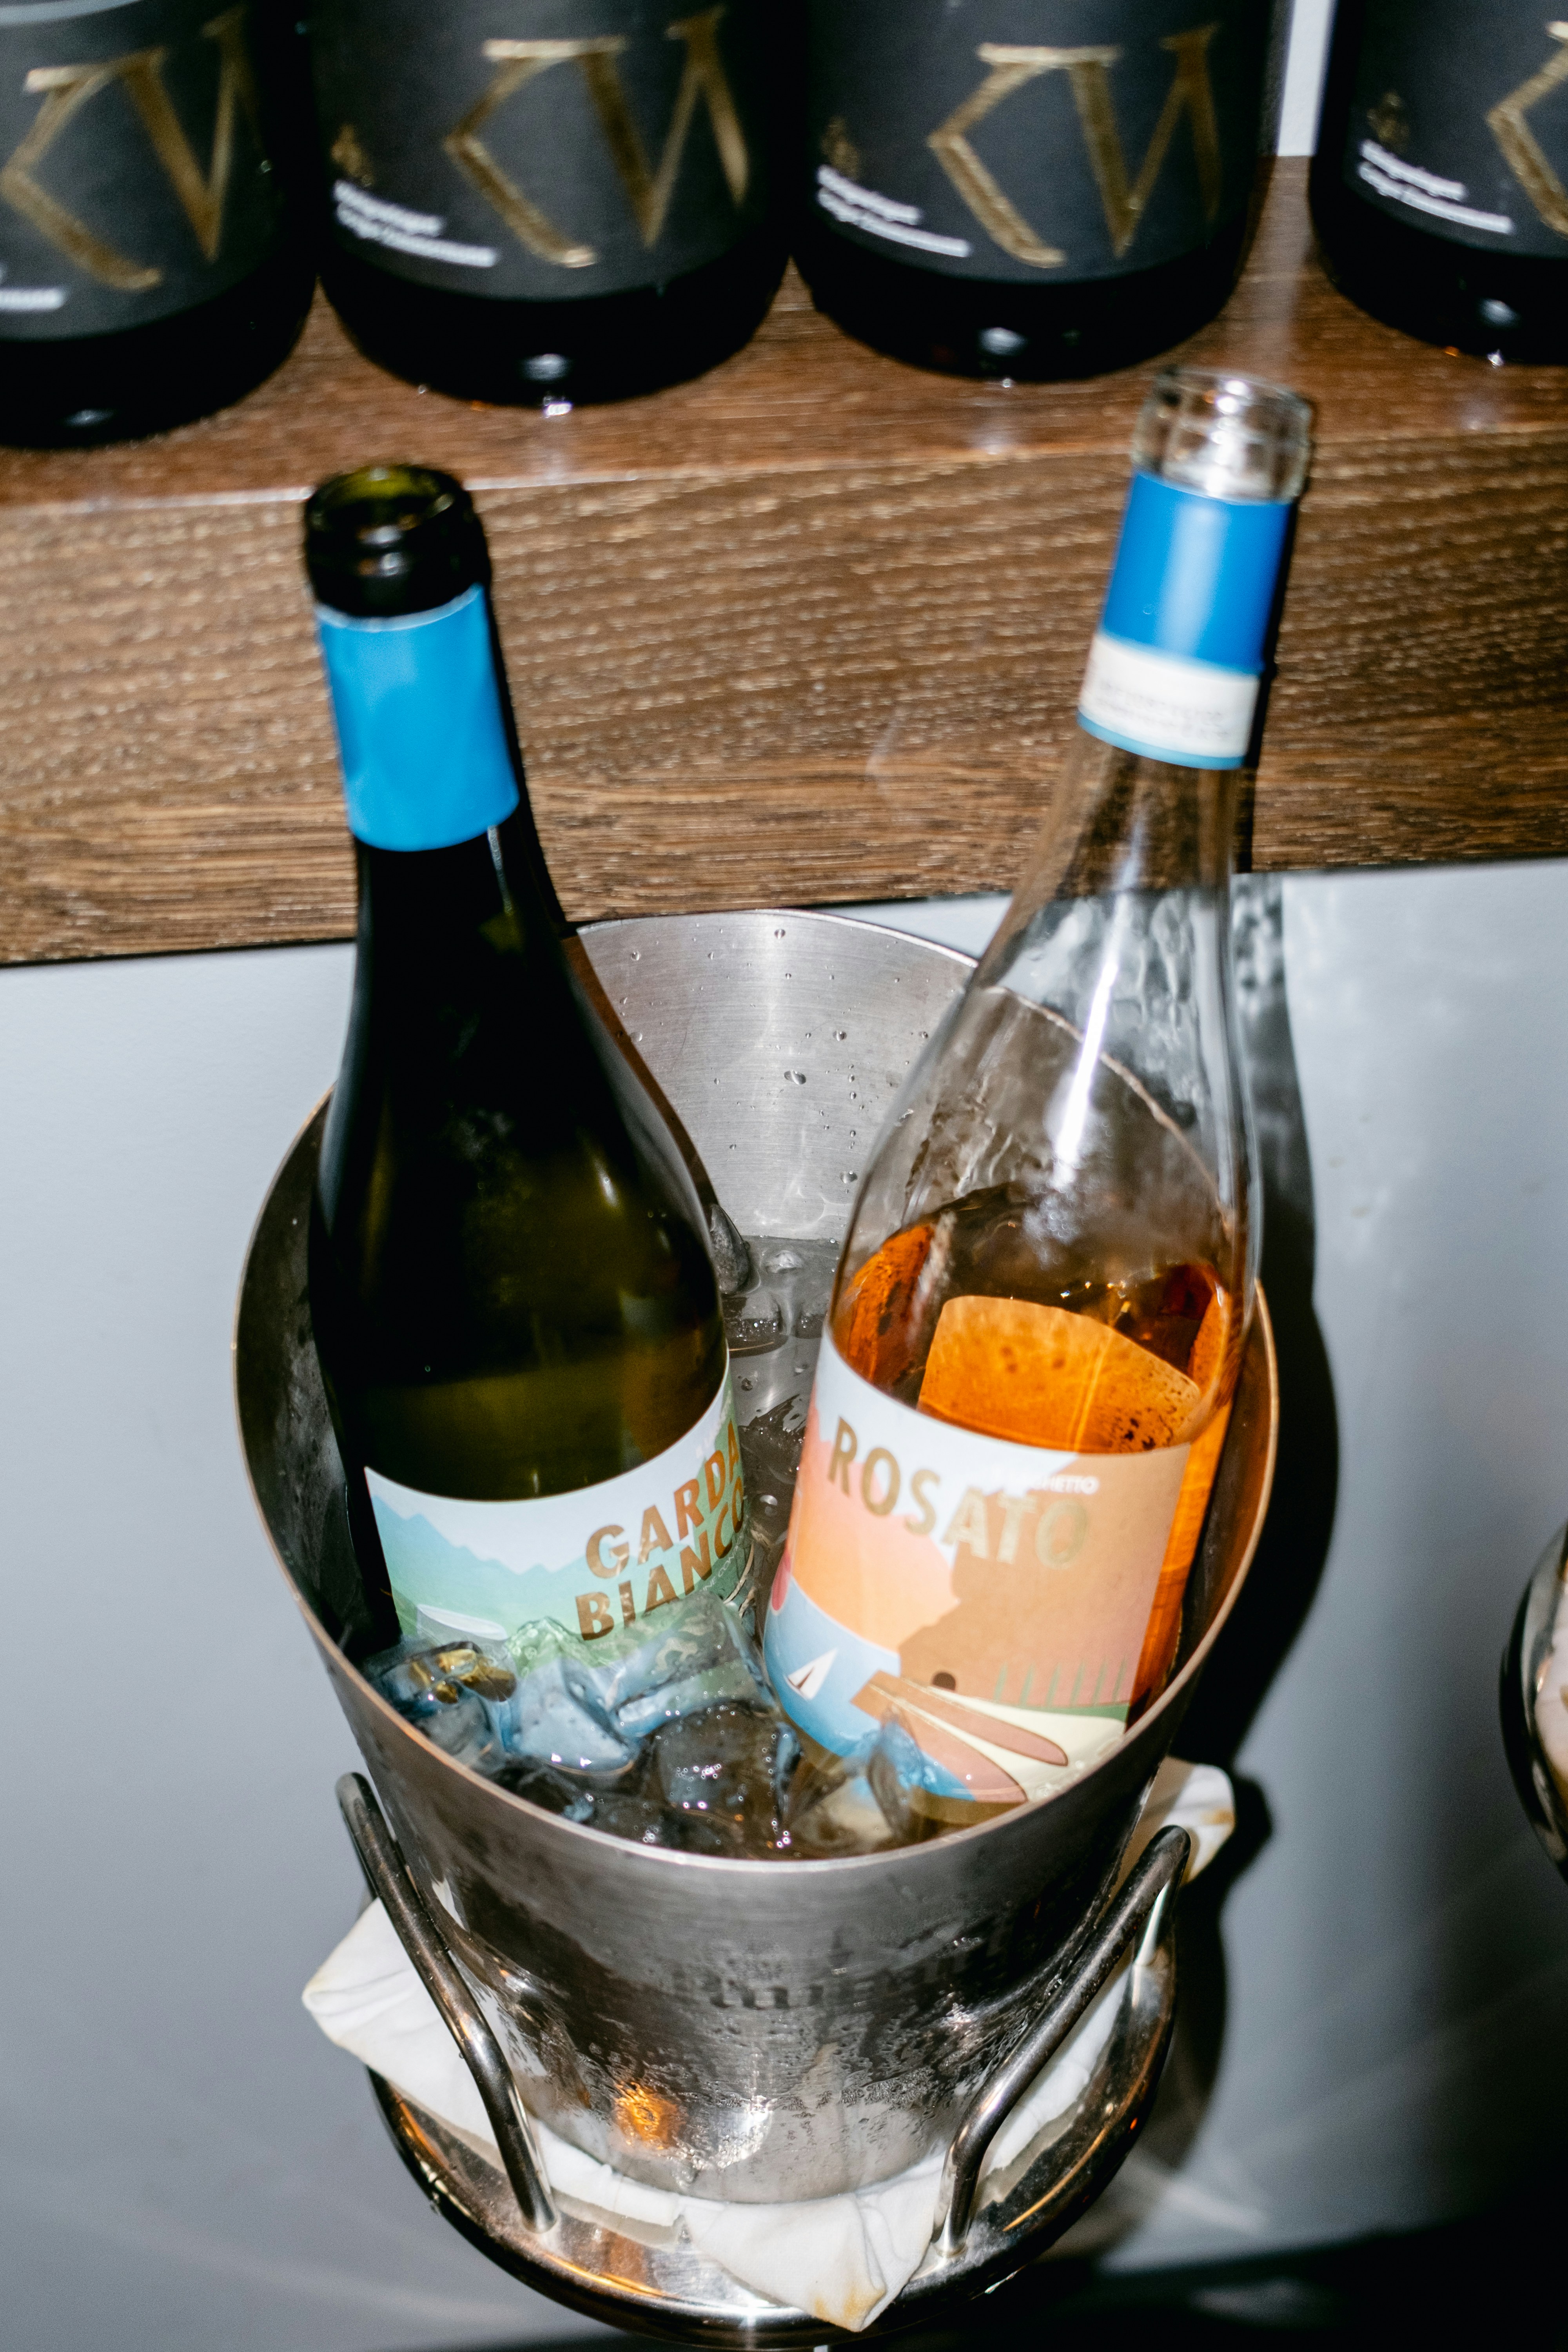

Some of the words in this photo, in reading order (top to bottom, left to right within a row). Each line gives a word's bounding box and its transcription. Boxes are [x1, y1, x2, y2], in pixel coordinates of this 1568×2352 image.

[575, 1477, 744, 1641] BIANCO
[585, 1419, 739, 1579] GARDA
[828, 1416, 1088, 1568] ROSATO
